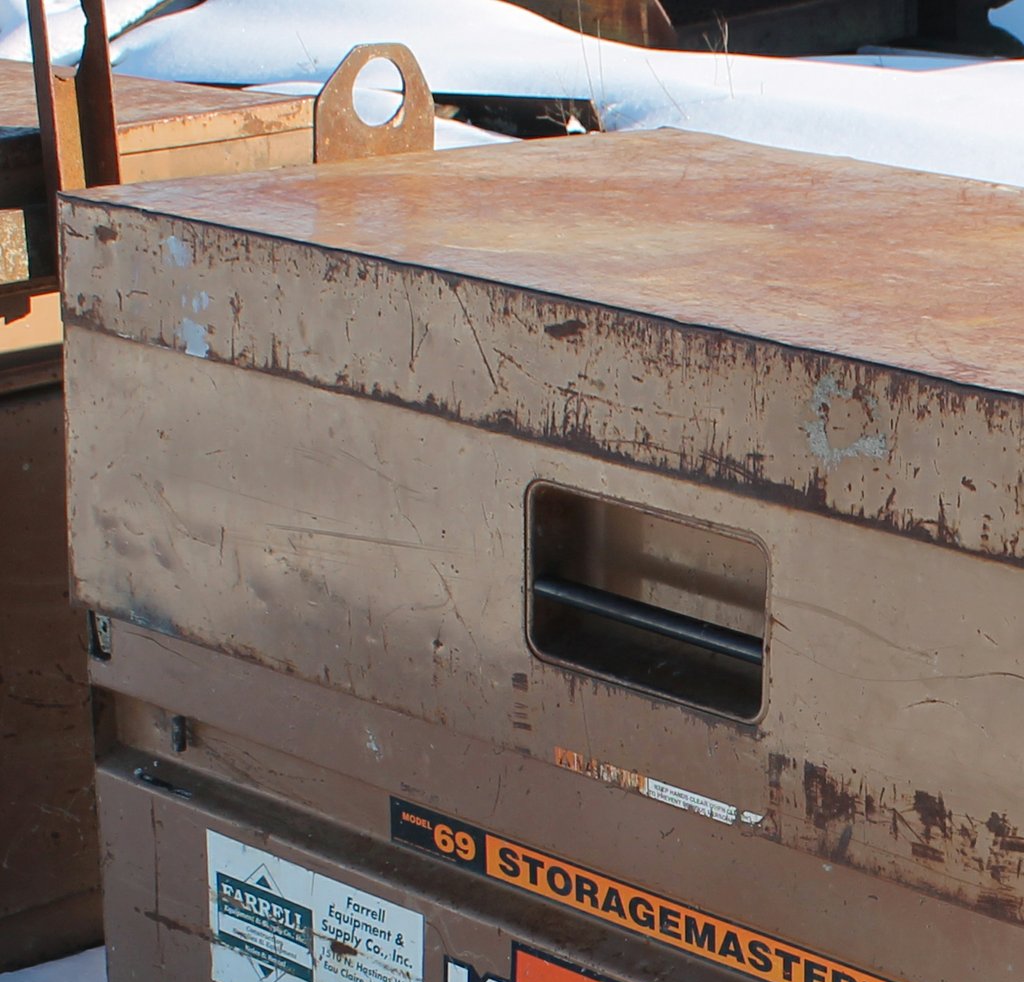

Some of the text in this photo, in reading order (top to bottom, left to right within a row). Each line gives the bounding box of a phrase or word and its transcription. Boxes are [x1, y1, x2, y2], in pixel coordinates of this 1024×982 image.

[402, 811, 433, 830] MODEL
[434, 823, 477, 861] 69
[221, 882, 306, 934] FARRELL
[328, 904, 405, 948] Equipment &
[346, 896, 386, 923] Farrell
[321, 919, 361, 949] Supply
[365, 938, 388, 960] Co.,
[392, 949, 413, 969] Inc.
[324, 961, 339, 975] Eau
